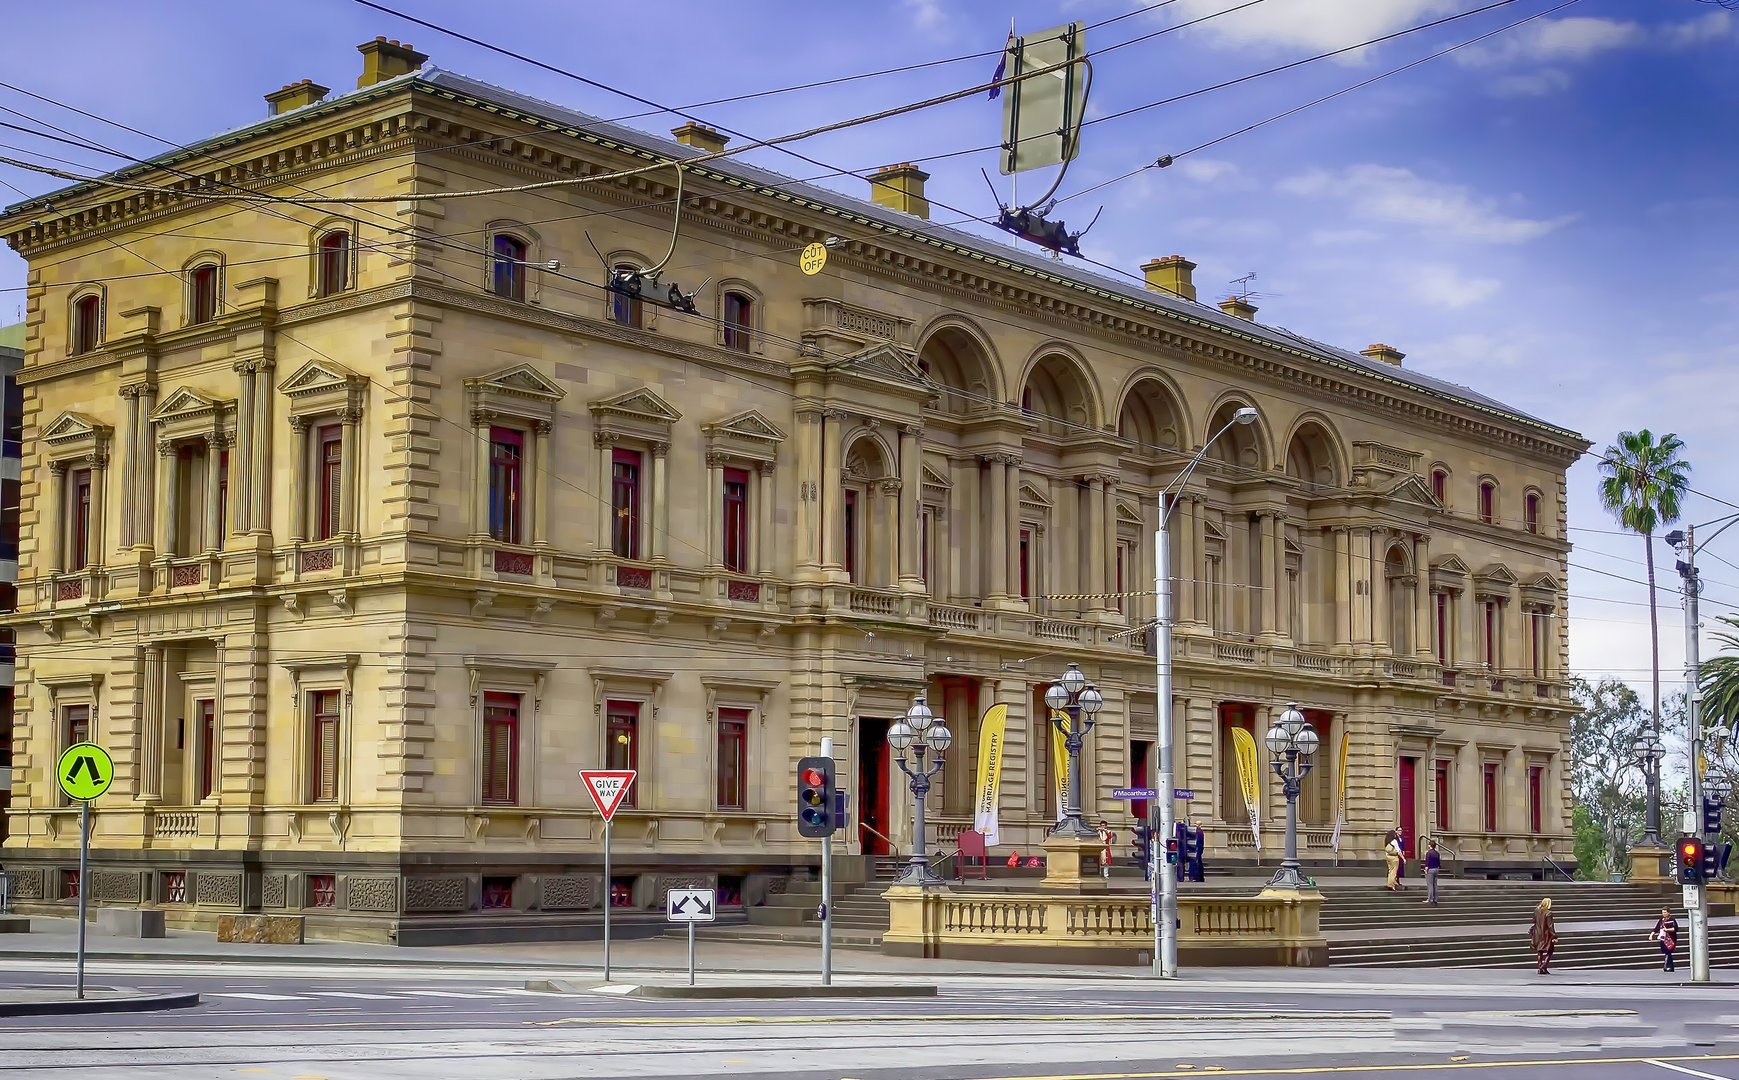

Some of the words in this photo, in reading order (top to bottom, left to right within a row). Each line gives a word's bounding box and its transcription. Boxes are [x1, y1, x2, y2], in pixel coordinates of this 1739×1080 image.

[803, 246, 823, 260] CUT
[804, 258, 823, 271] OFF
[988, 732, 998, 772] REGISTRY
[595, 780, 619, 789] GIVE
[986, 772, 995, 813] MARRIAGE
